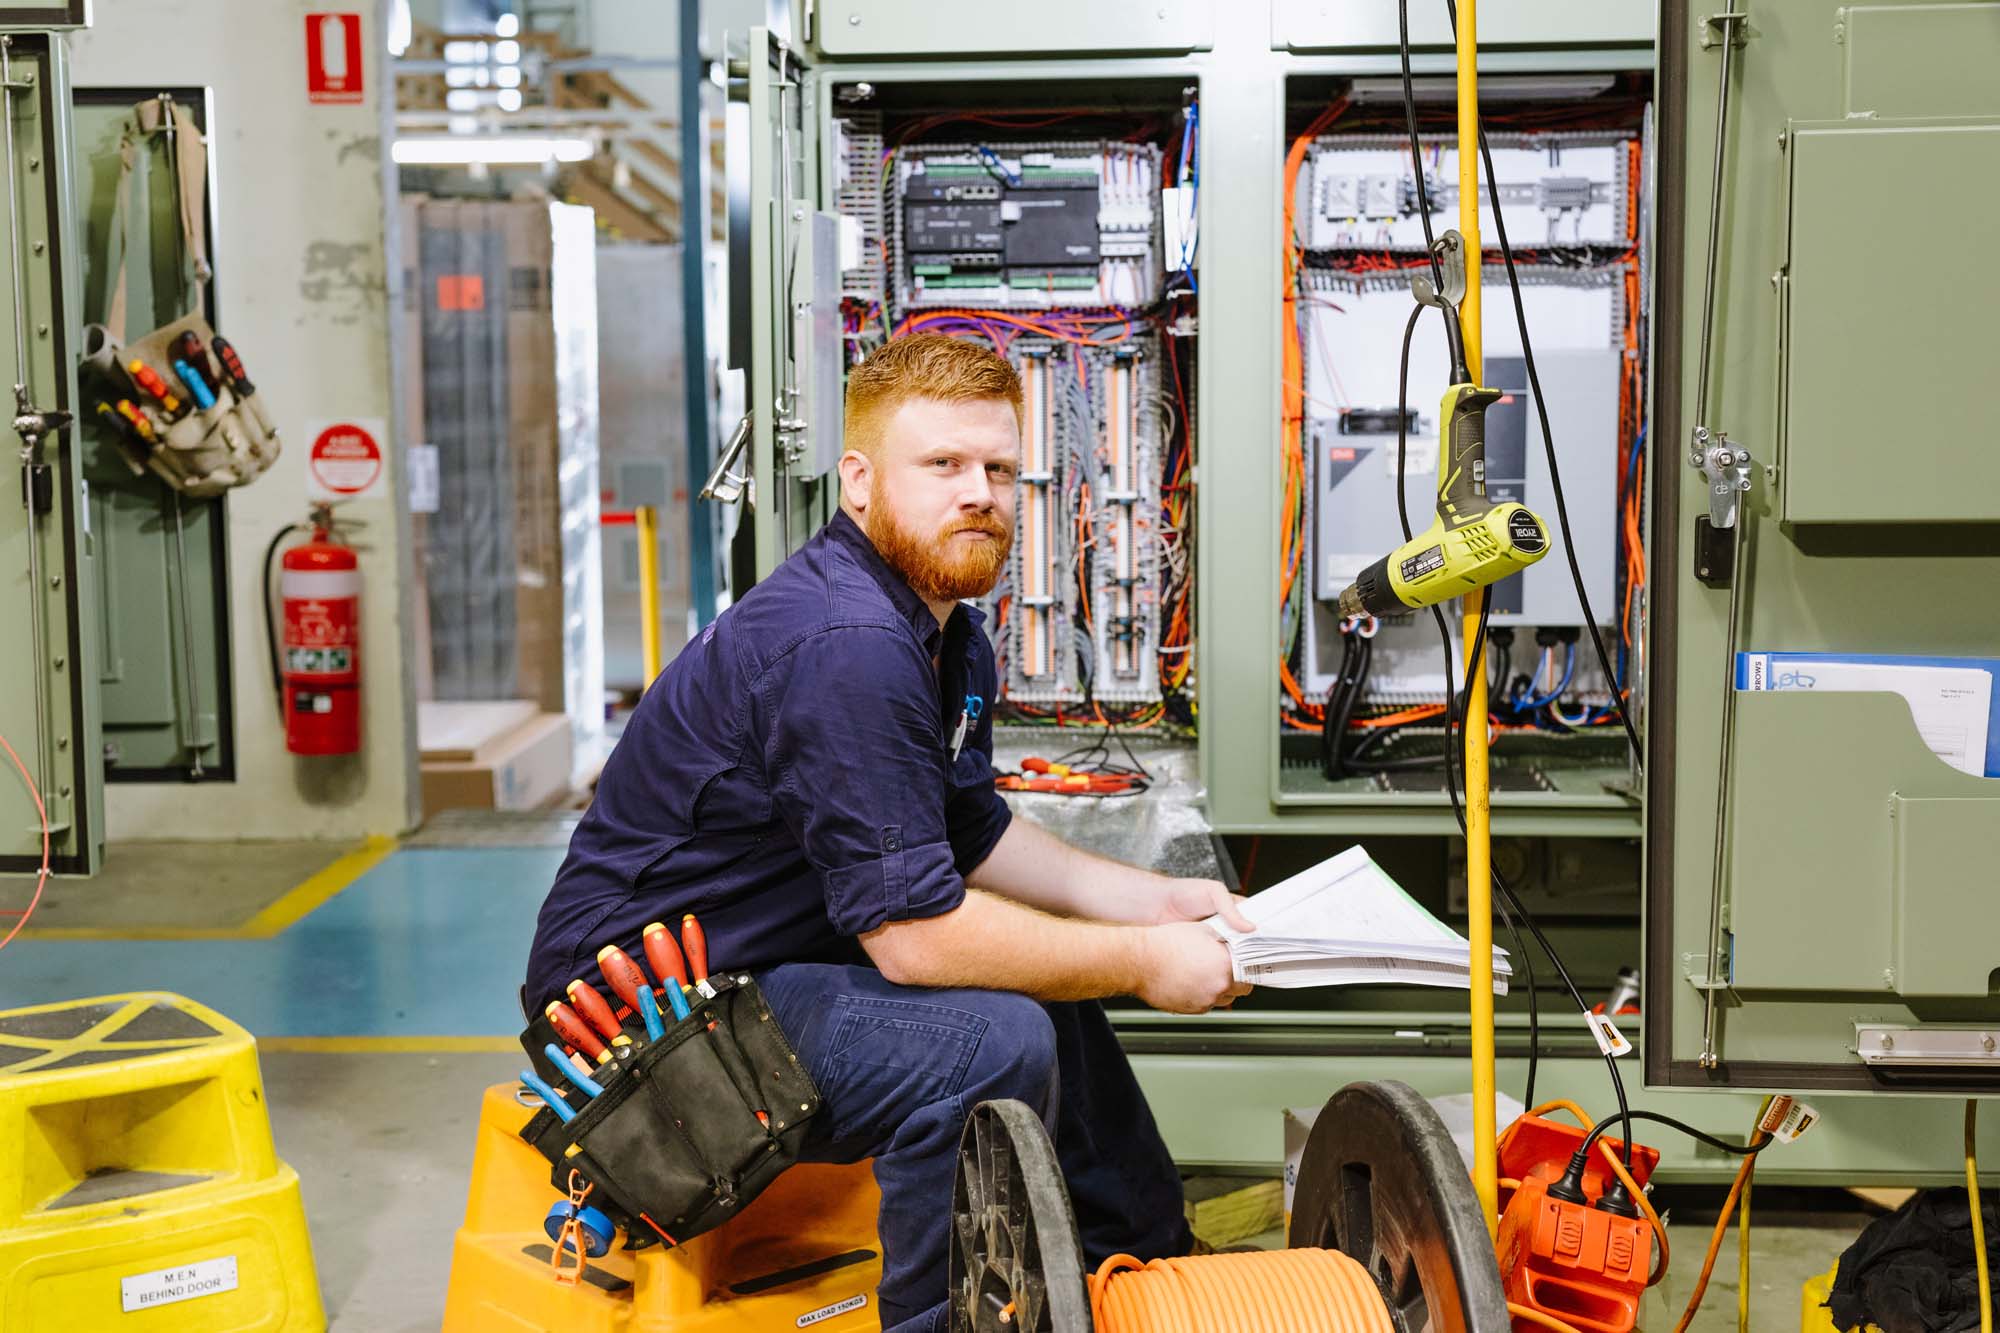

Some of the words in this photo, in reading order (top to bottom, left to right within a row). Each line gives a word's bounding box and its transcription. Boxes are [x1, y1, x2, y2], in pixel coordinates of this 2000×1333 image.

[1515, 528, 1537, 538] RYOBI
[1764, 1098, 1785, 1129] CAUTION
[140, 1286, 184, 1303] BEHIND
[187, 1278, 221, 1293] DOOR
[800, 1315, 816, 1324] MAX
[817, 1308, 836, 1318] LOAD
